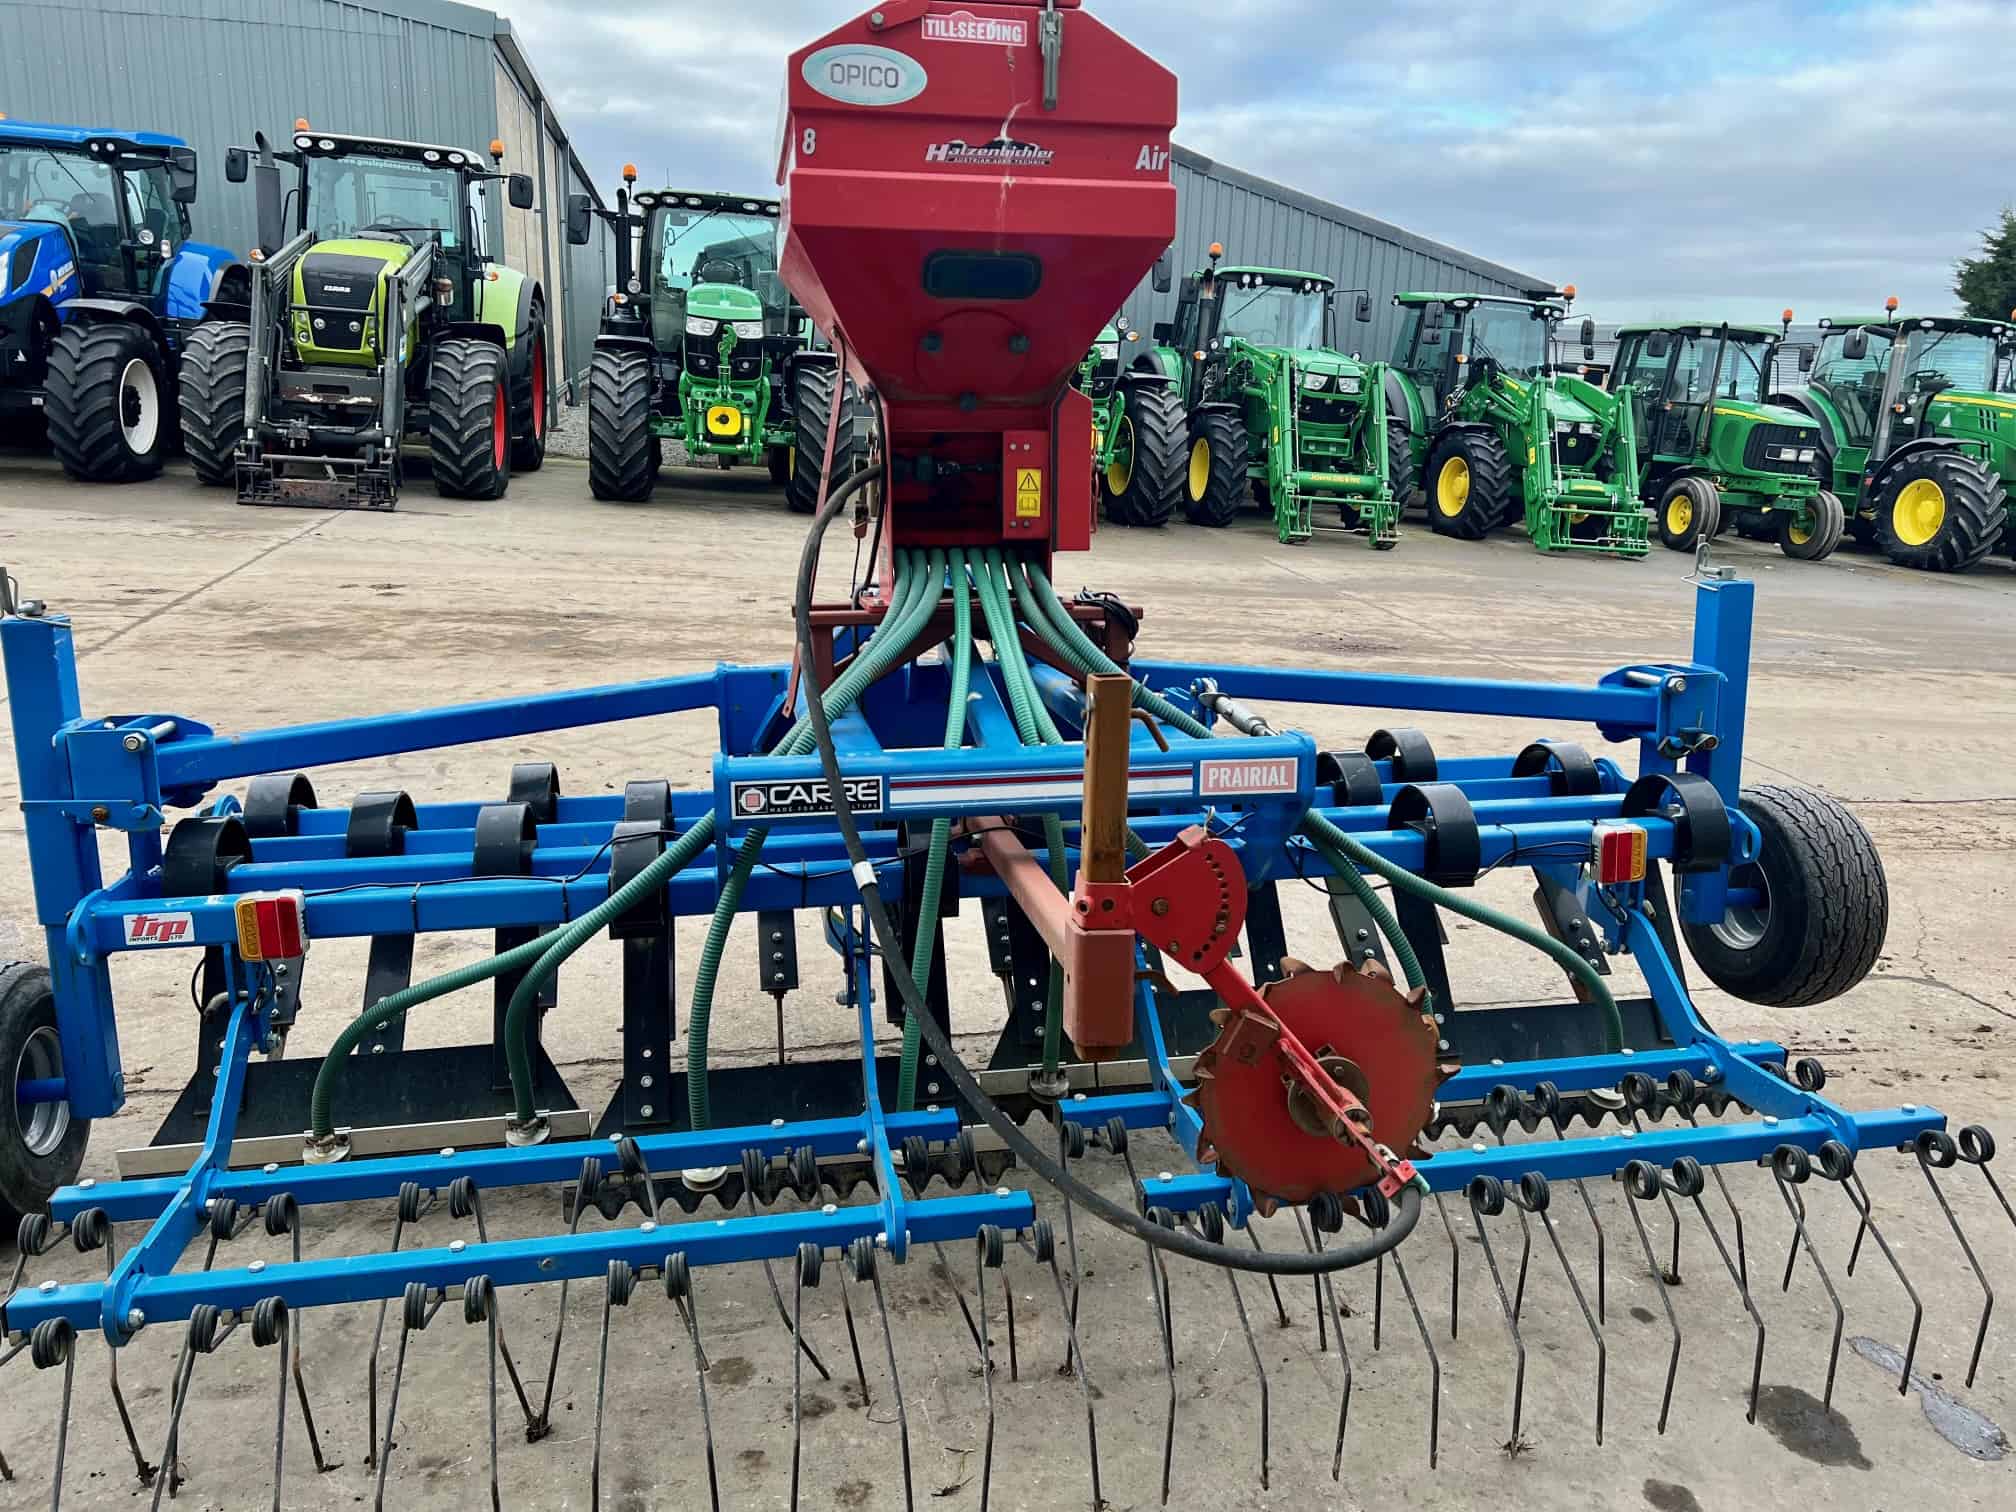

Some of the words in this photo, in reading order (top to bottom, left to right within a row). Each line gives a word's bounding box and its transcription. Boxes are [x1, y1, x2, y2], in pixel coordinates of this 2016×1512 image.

[925, 18, 1023, 42] TILLSEEDING
[830, 63, 899, 88] OPICO
[356, 143, 404, 155] AXION
[802, 128, 816, 155] 8
[1135, 144, 1169, 170] Air
[1208, 765, 1289, 788] PRAIRIAL
